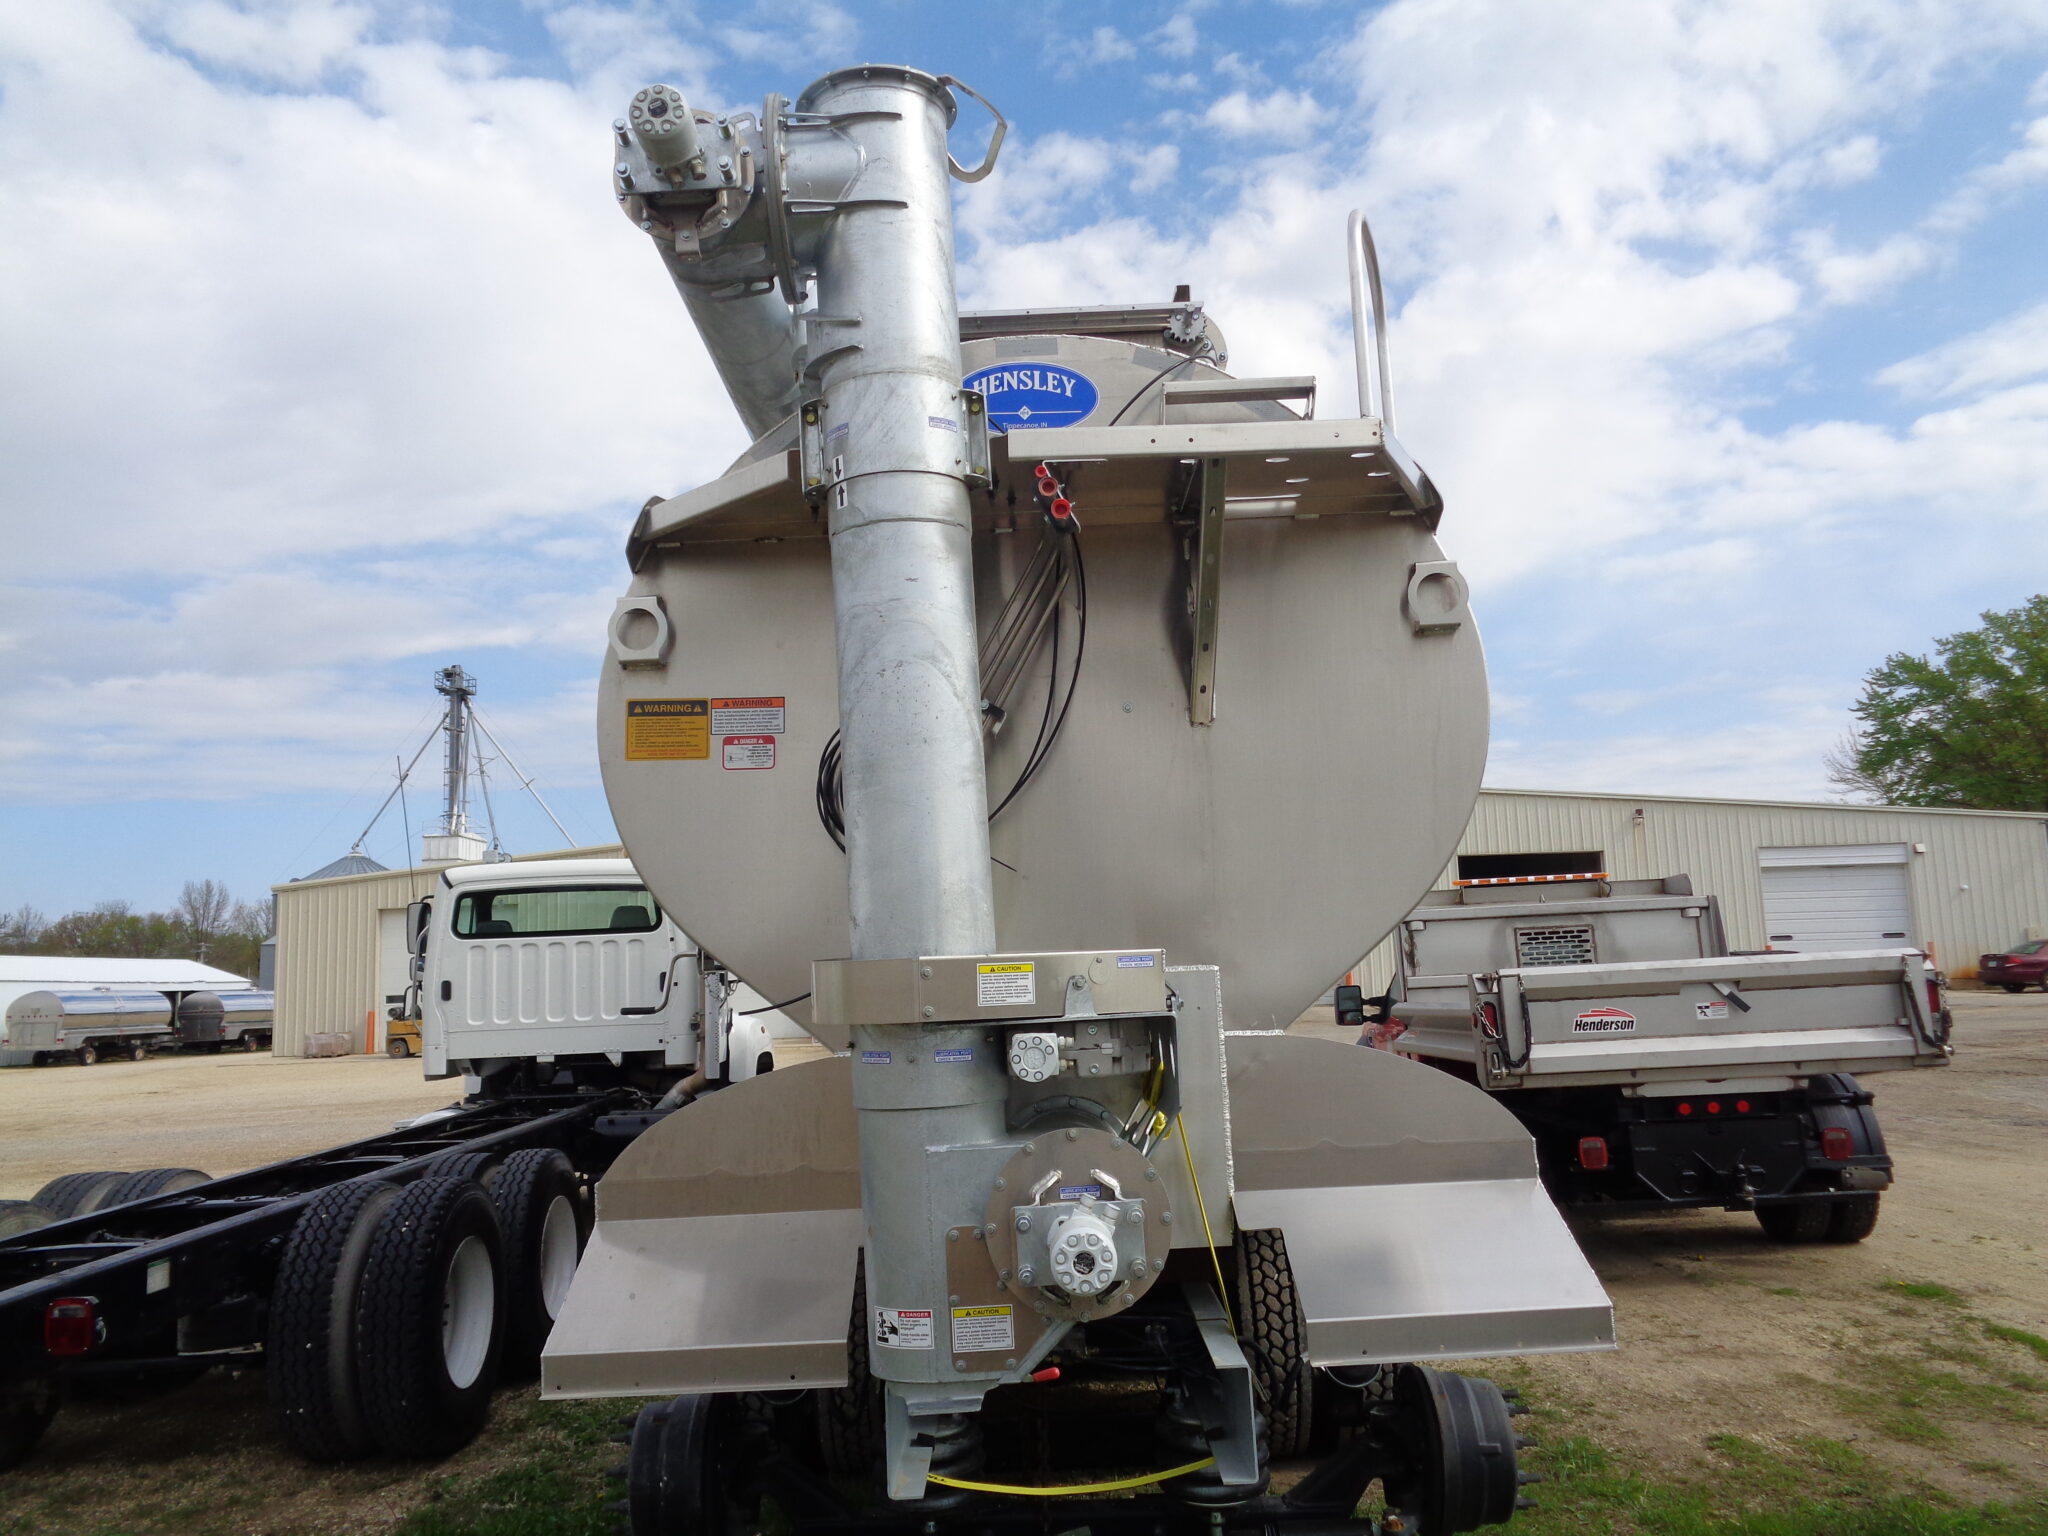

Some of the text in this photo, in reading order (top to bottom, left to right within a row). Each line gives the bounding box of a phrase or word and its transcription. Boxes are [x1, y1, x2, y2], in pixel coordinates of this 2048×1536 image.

[973, 371, 1076, 397] HENSLEY
[644, 704, 692, 712] WARNING
[732, 699, 772, 707] WARNING
[1574, 1019, 1634, 1031] Henderson
